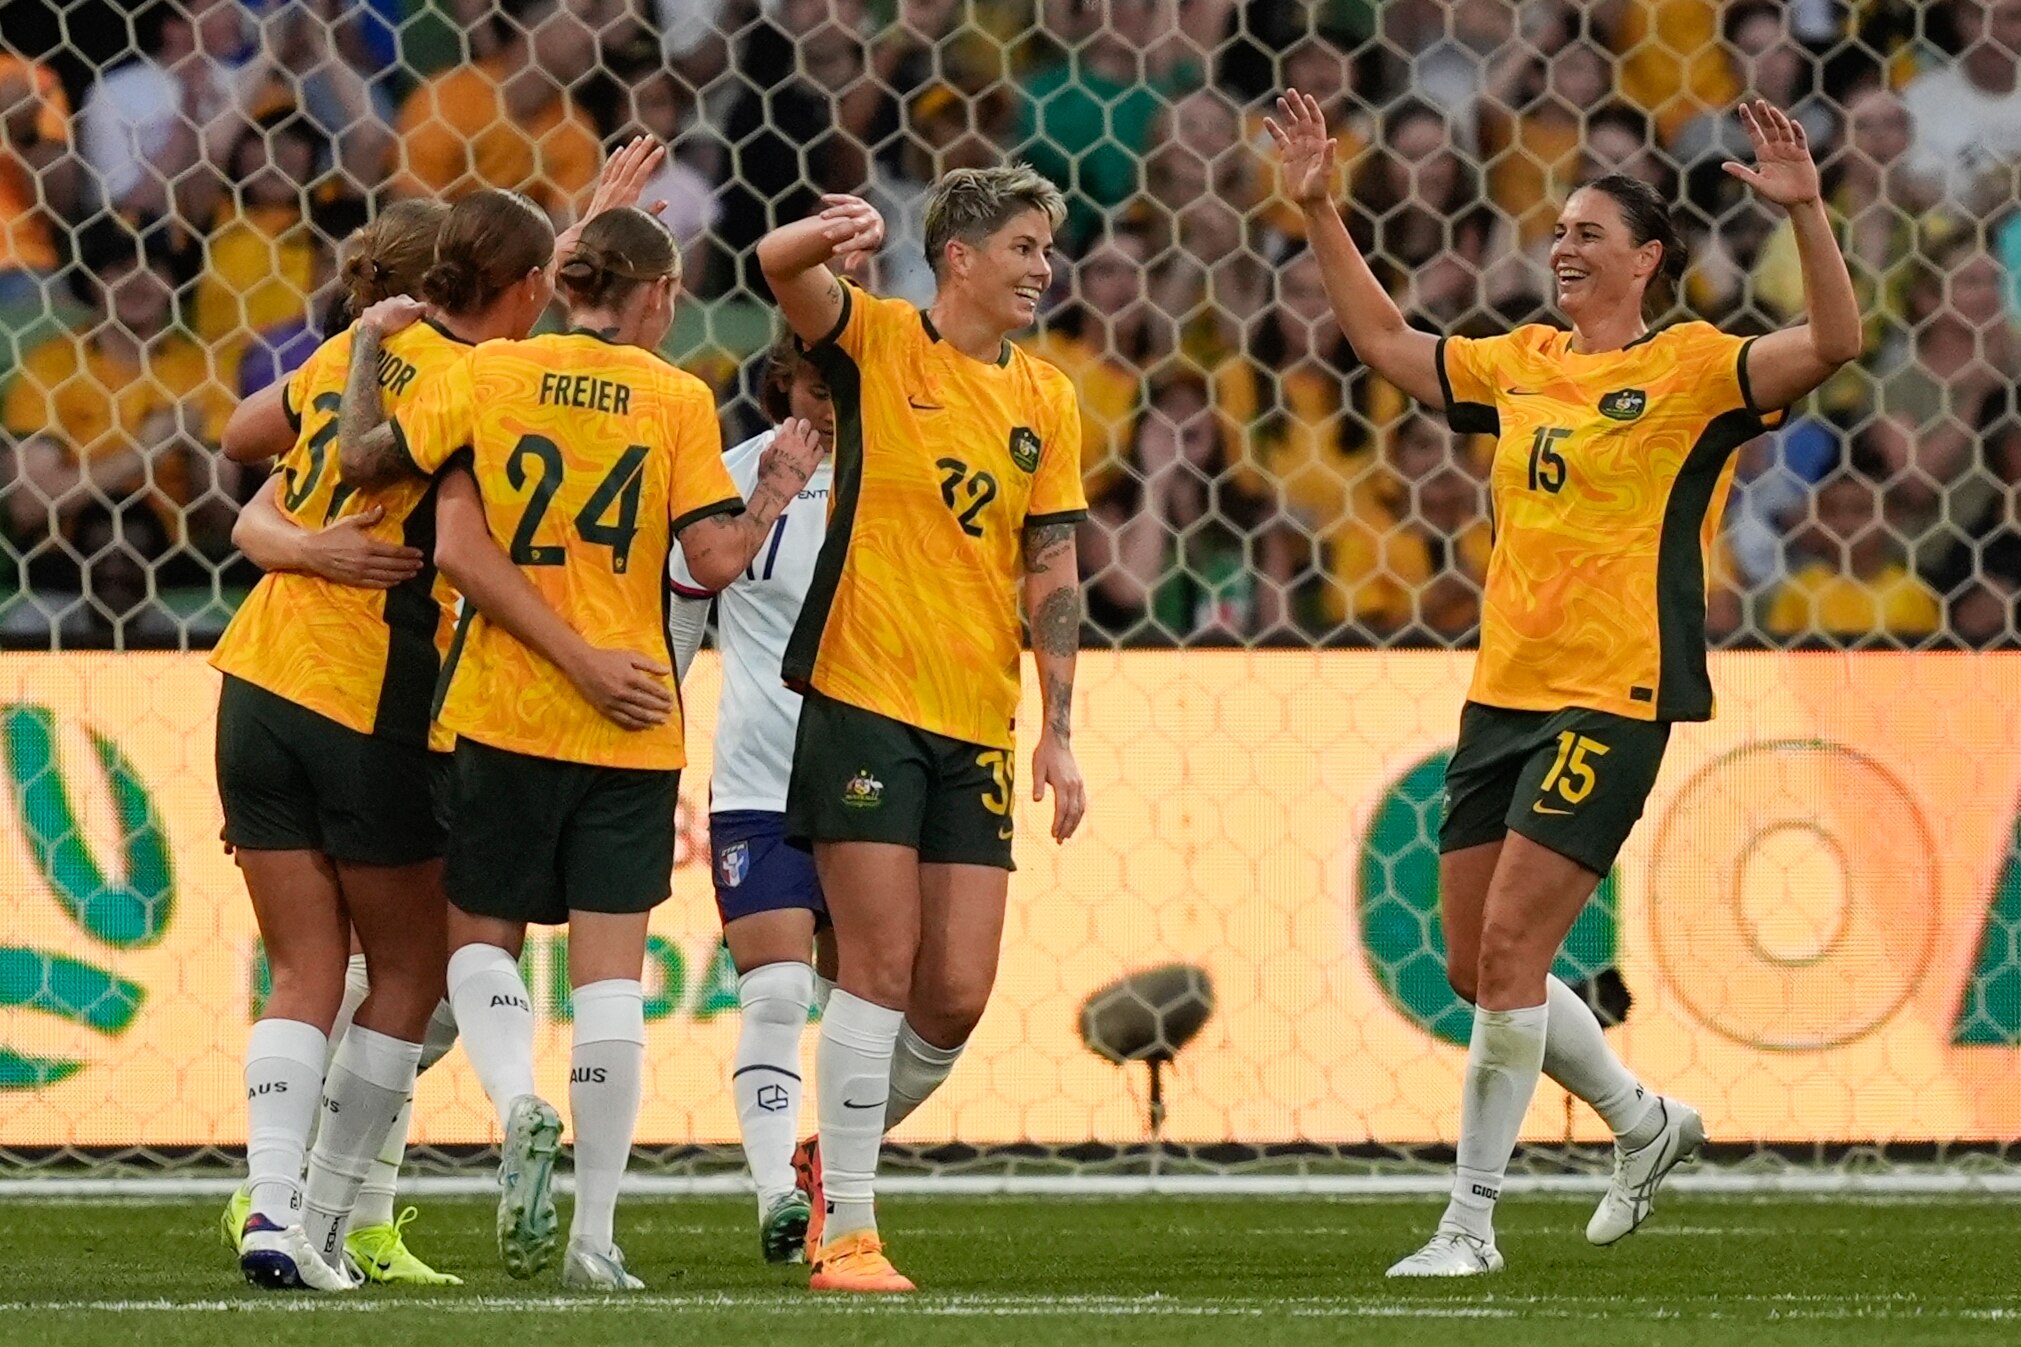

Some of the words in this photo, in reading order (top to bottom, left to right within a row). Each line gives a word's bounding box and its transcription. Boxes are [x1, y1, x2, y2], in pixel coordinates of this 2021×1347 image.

[539, 372, 630, 415] FREIER
[285, 391, 355, 527] 3
[1528, 426, 1574, 494] 15
[506, 434, 650, 574] 24
[975, 750, 1014, 816] 3
[1540, 730, 1610, 804] 15
[490, 994, 529, 1012] AUS
[248, 1082, 288, 1100] AUS
[570, 1067, 607, 1084] AUS
